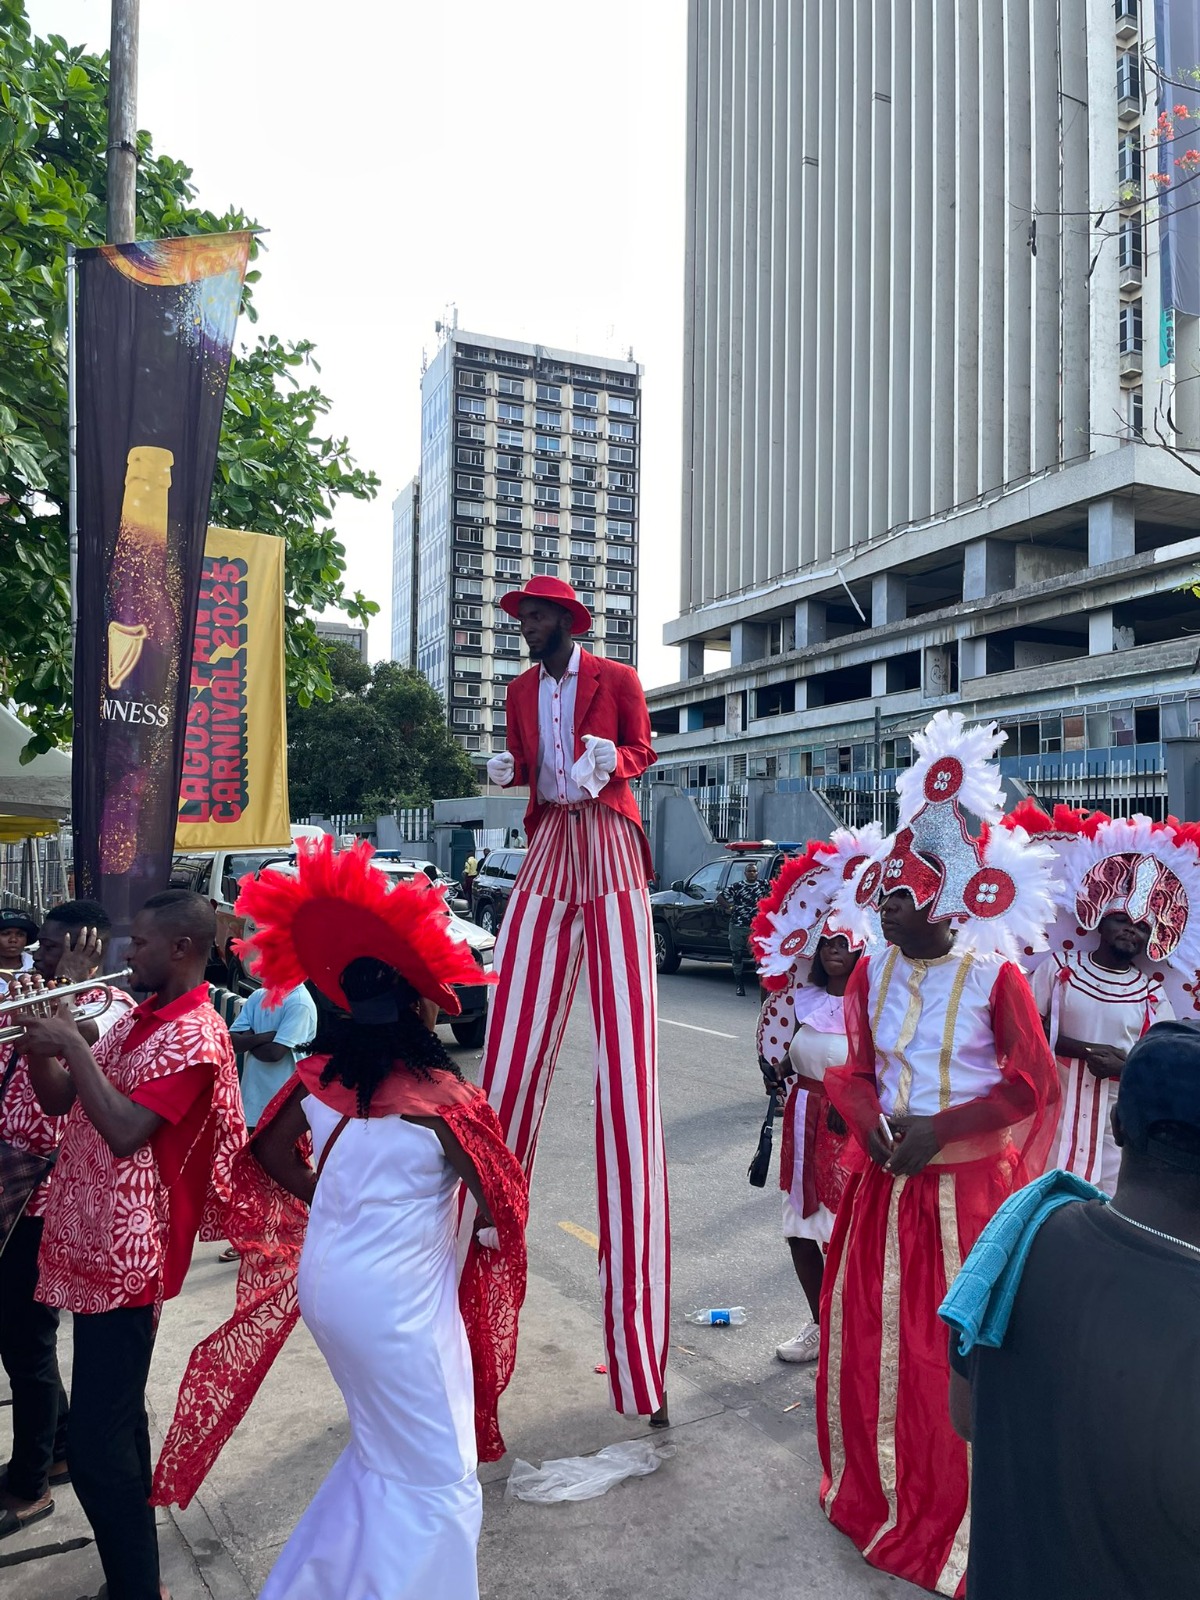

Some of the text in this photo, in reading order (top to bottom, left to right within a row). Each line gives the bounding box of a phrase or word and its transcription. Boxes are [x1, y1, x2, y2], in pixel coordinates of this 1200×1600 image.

[178, 701, 210, 823] LAGOS
[211, 561, 242, 824] CARNIVAL 2025
